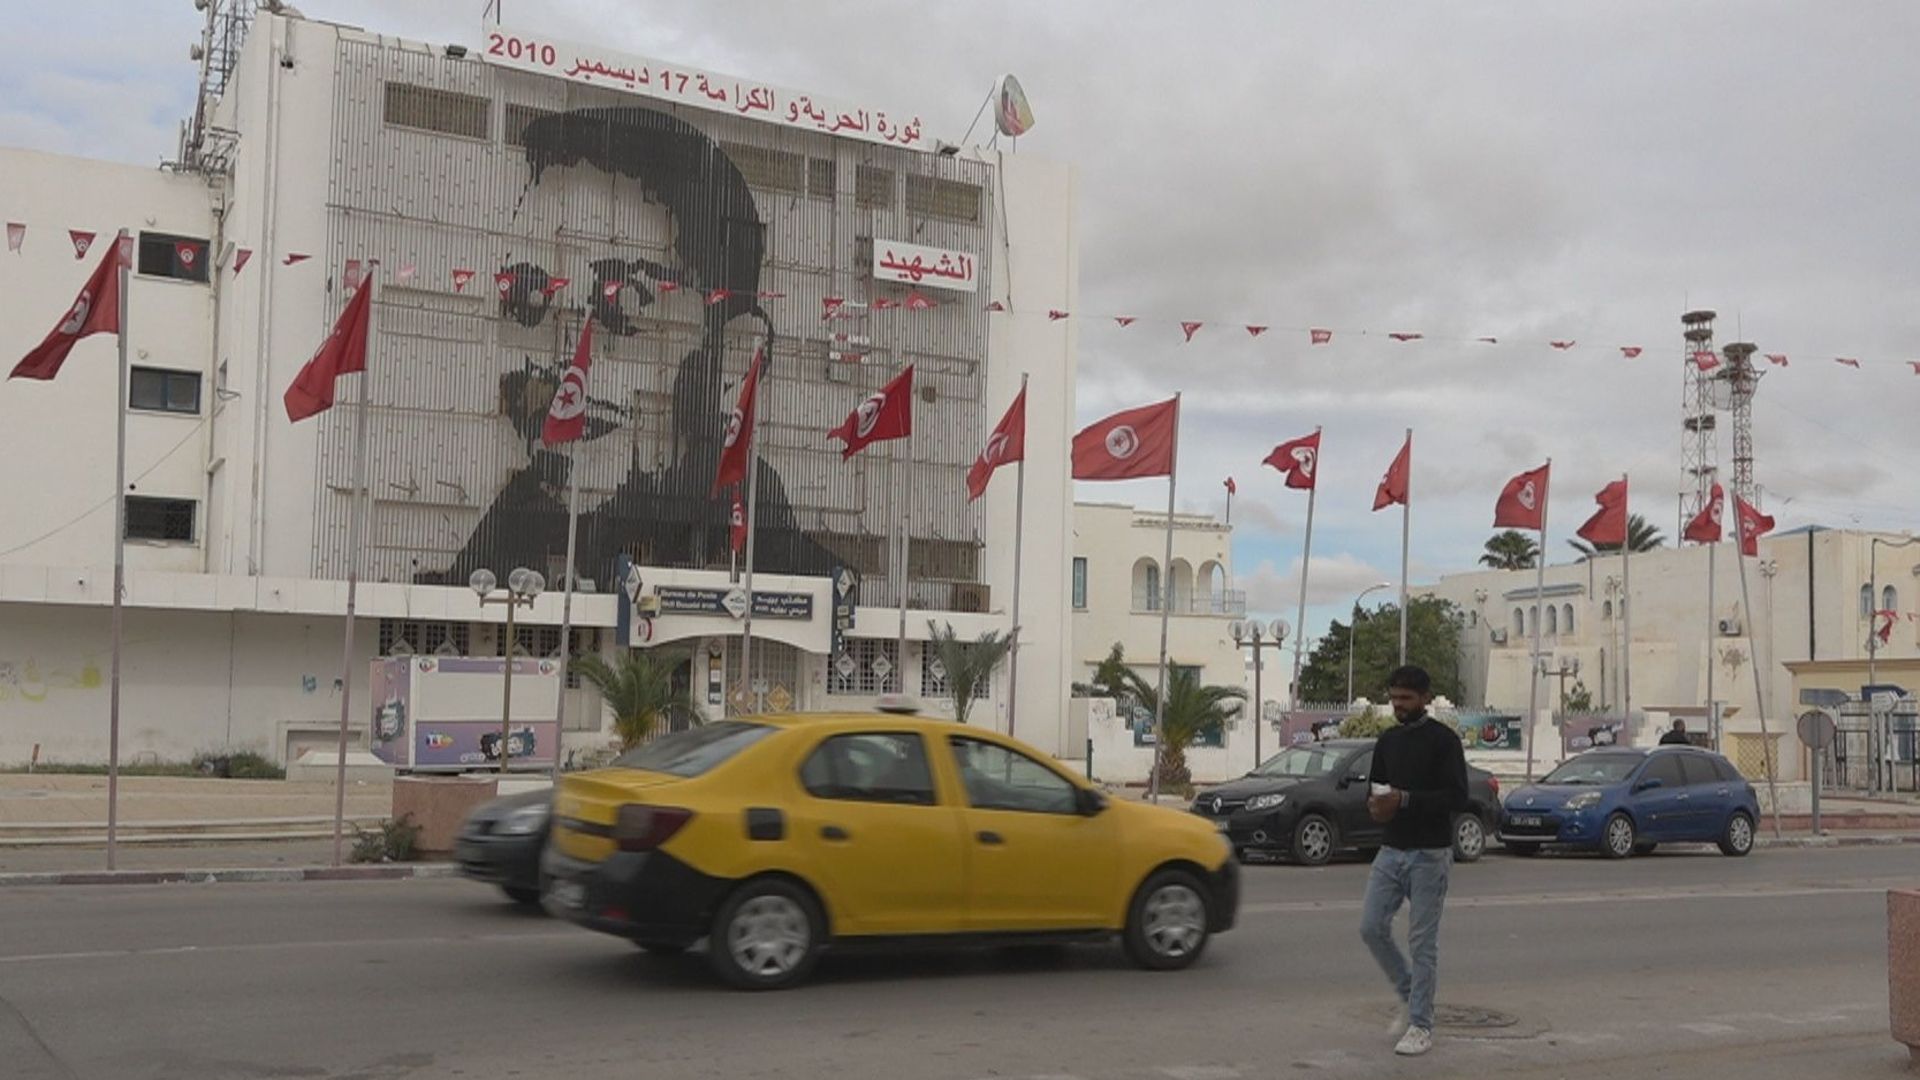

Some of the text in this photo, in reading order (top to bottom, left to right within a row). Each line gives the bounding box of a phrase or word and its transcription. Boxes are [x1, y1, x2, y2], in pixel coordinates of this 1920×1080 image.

[488, 33, 556, 66] 2010
[564, 56, 650, 89] ديسمبر
[660, 71, 689, 93] 17
[877, 111, 921, 143] ثورة
[880, 250, 972, 282] الشهيد
